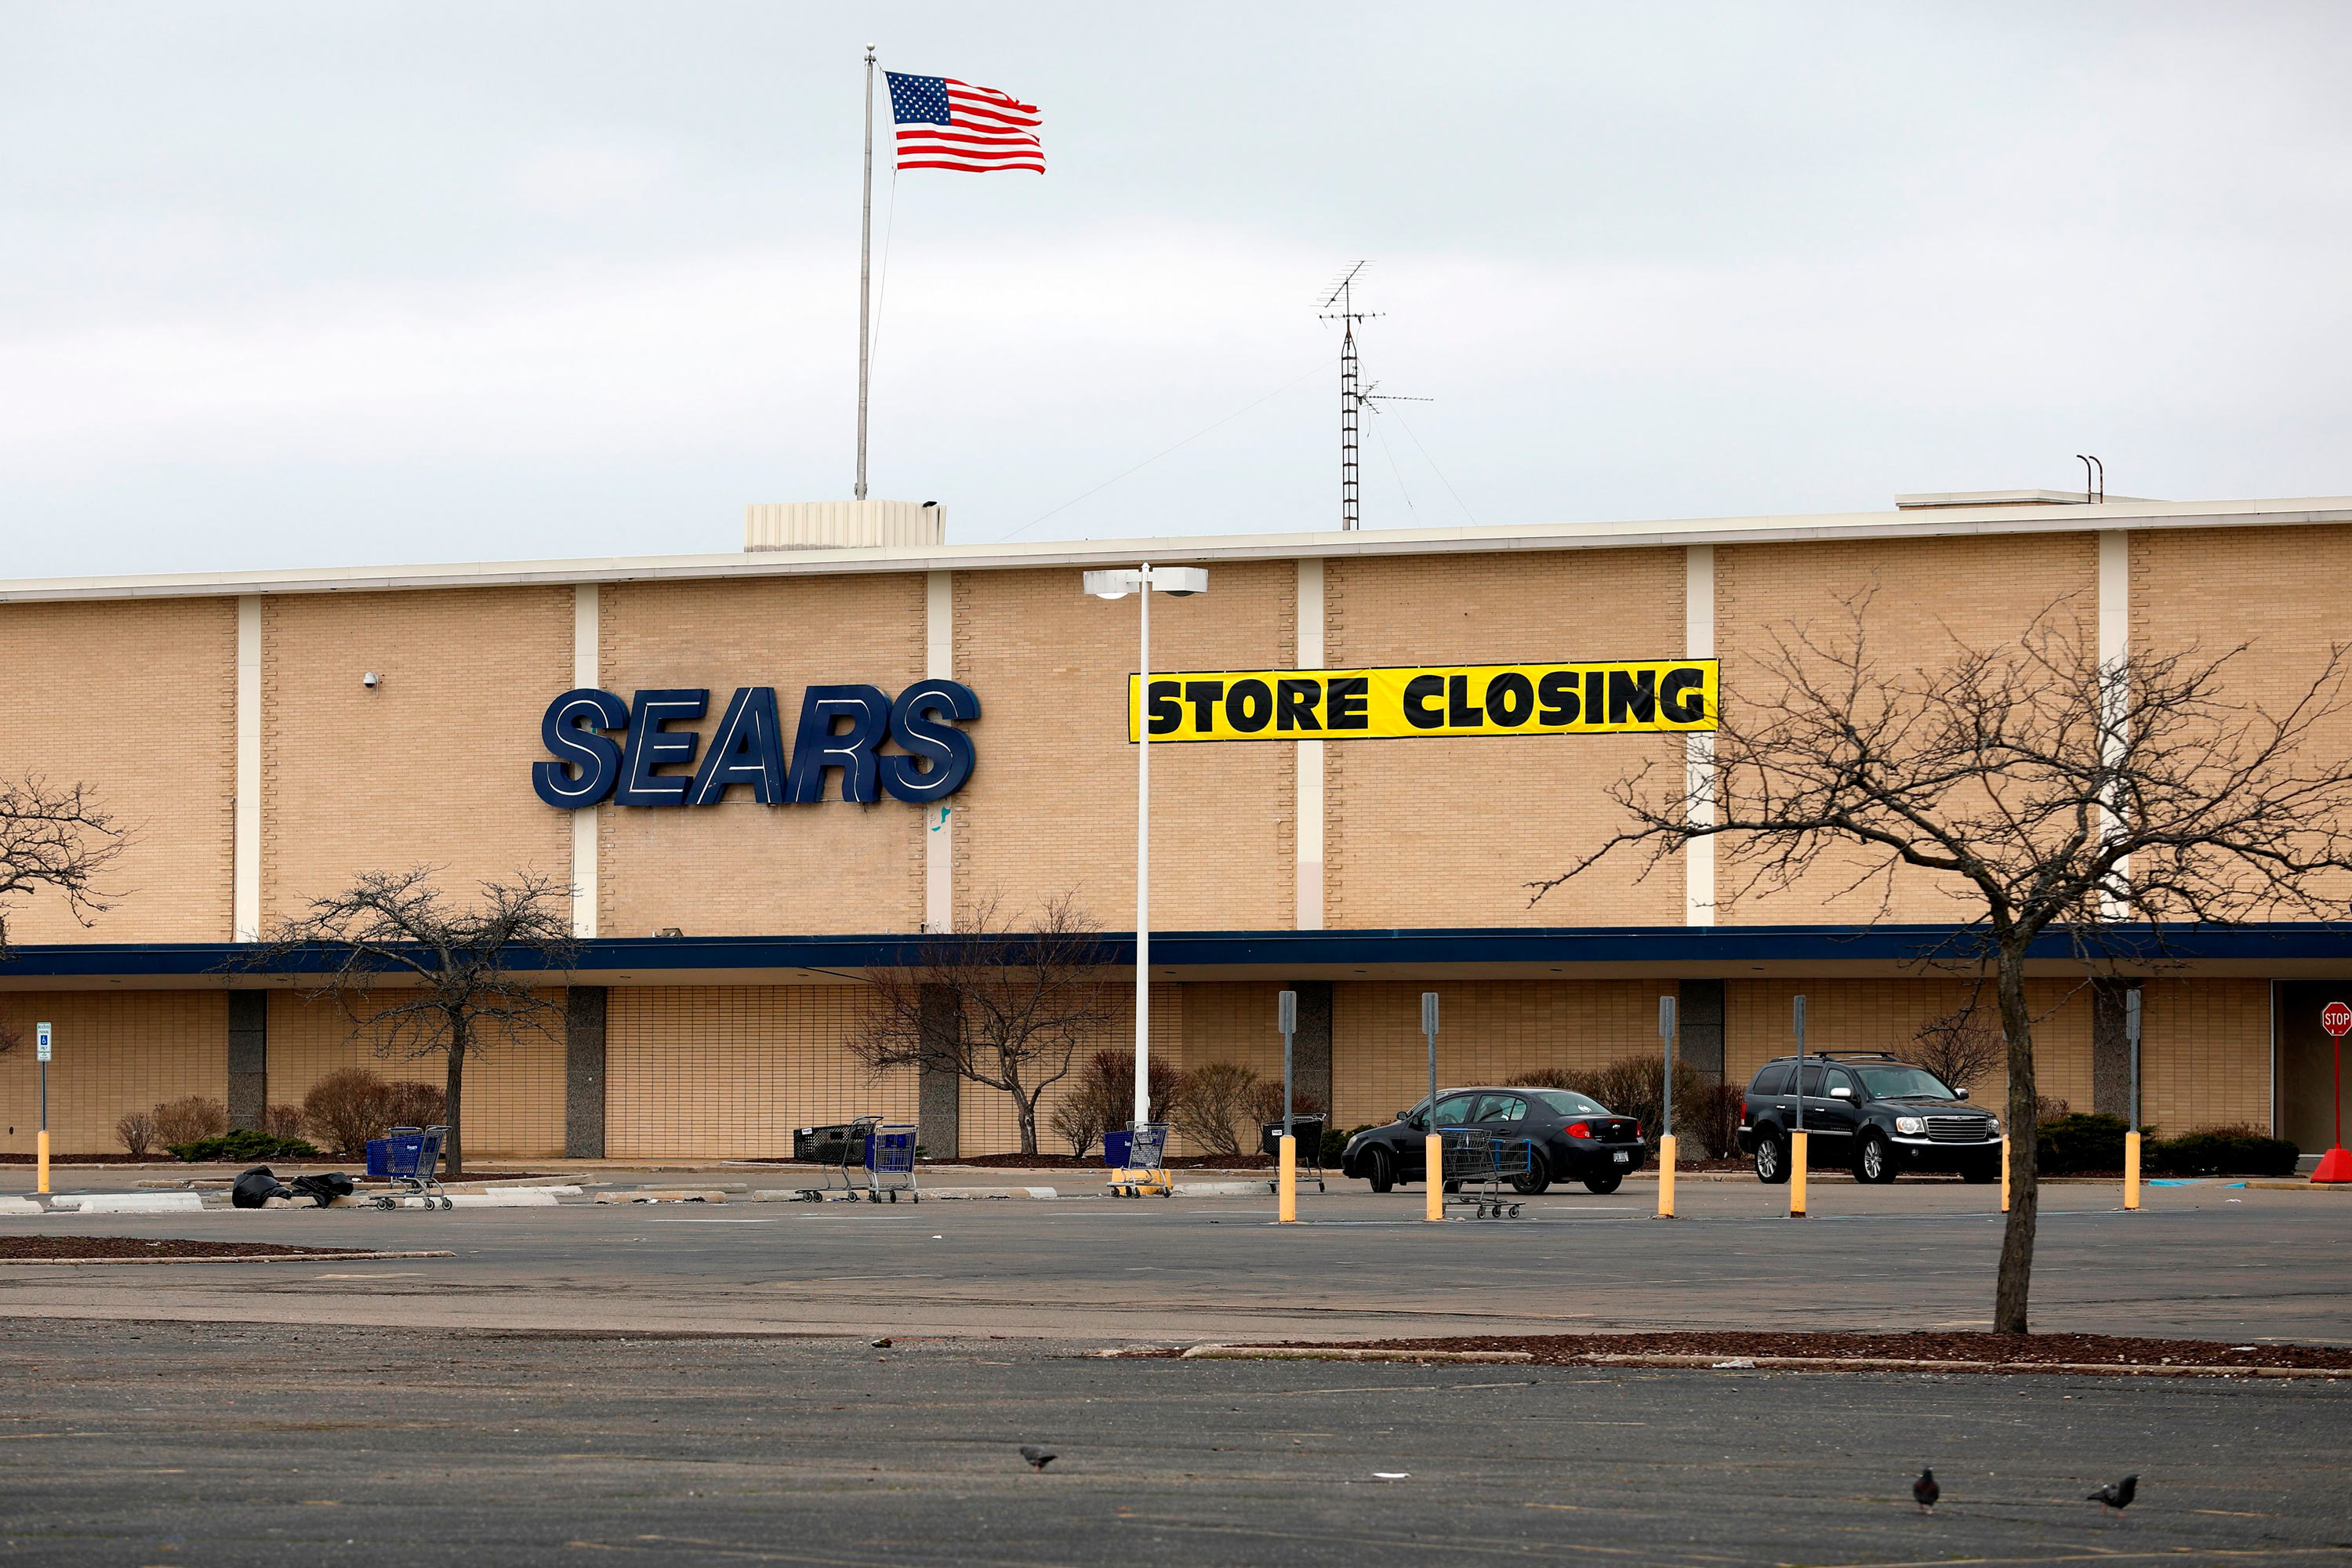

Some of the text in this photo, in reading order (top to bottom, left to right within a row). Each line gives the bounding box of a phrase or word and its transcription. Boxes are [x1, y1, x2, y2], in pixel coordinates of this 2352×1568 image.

[1149, 668, 1704, 735] STORE CLOSING
[532, 678, 982, 809] SEARS
[2325, 1013, 2350, 1025] STOP
